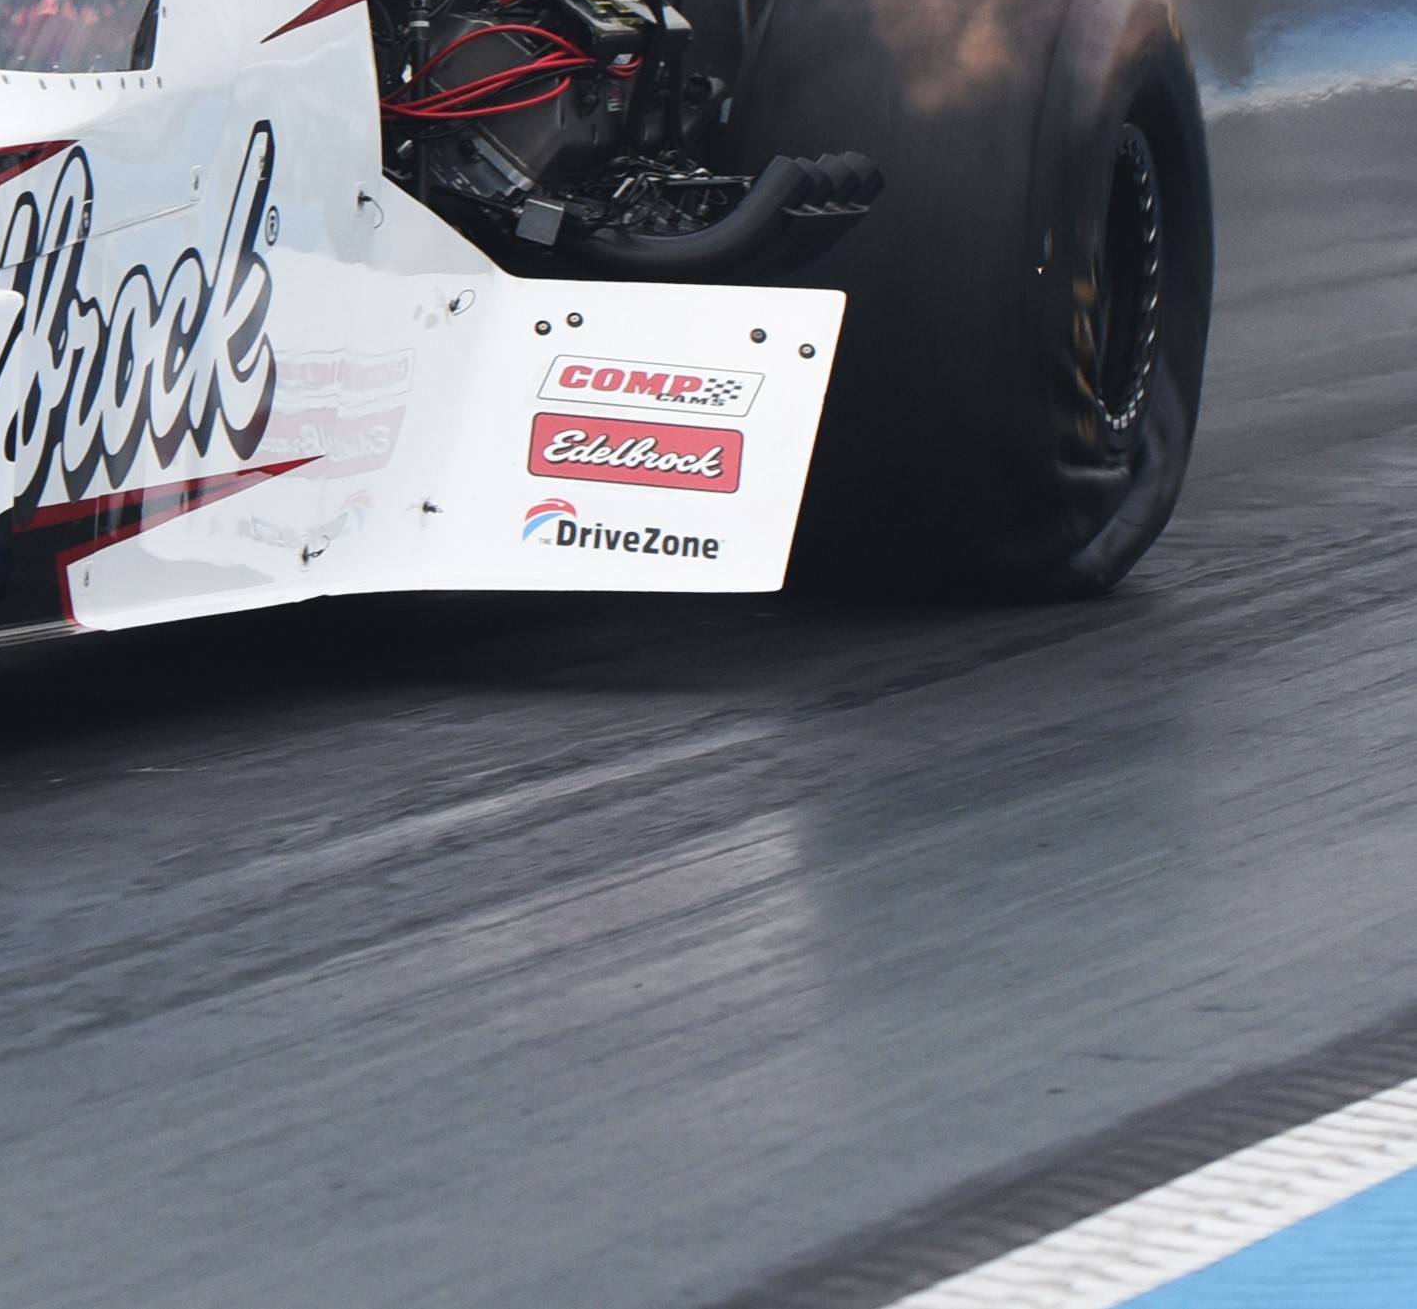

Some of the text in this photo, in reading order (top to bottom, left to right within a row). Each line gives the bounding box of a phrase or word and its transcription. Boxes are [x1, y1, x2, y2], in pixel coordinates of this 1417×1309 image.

[558, 364, 703, 396] COMP
[656, 393, 725, 407] CAMS
[542, 428, 725, 479] Edelbrock
[556, 519, 720, 560] DriveZone
